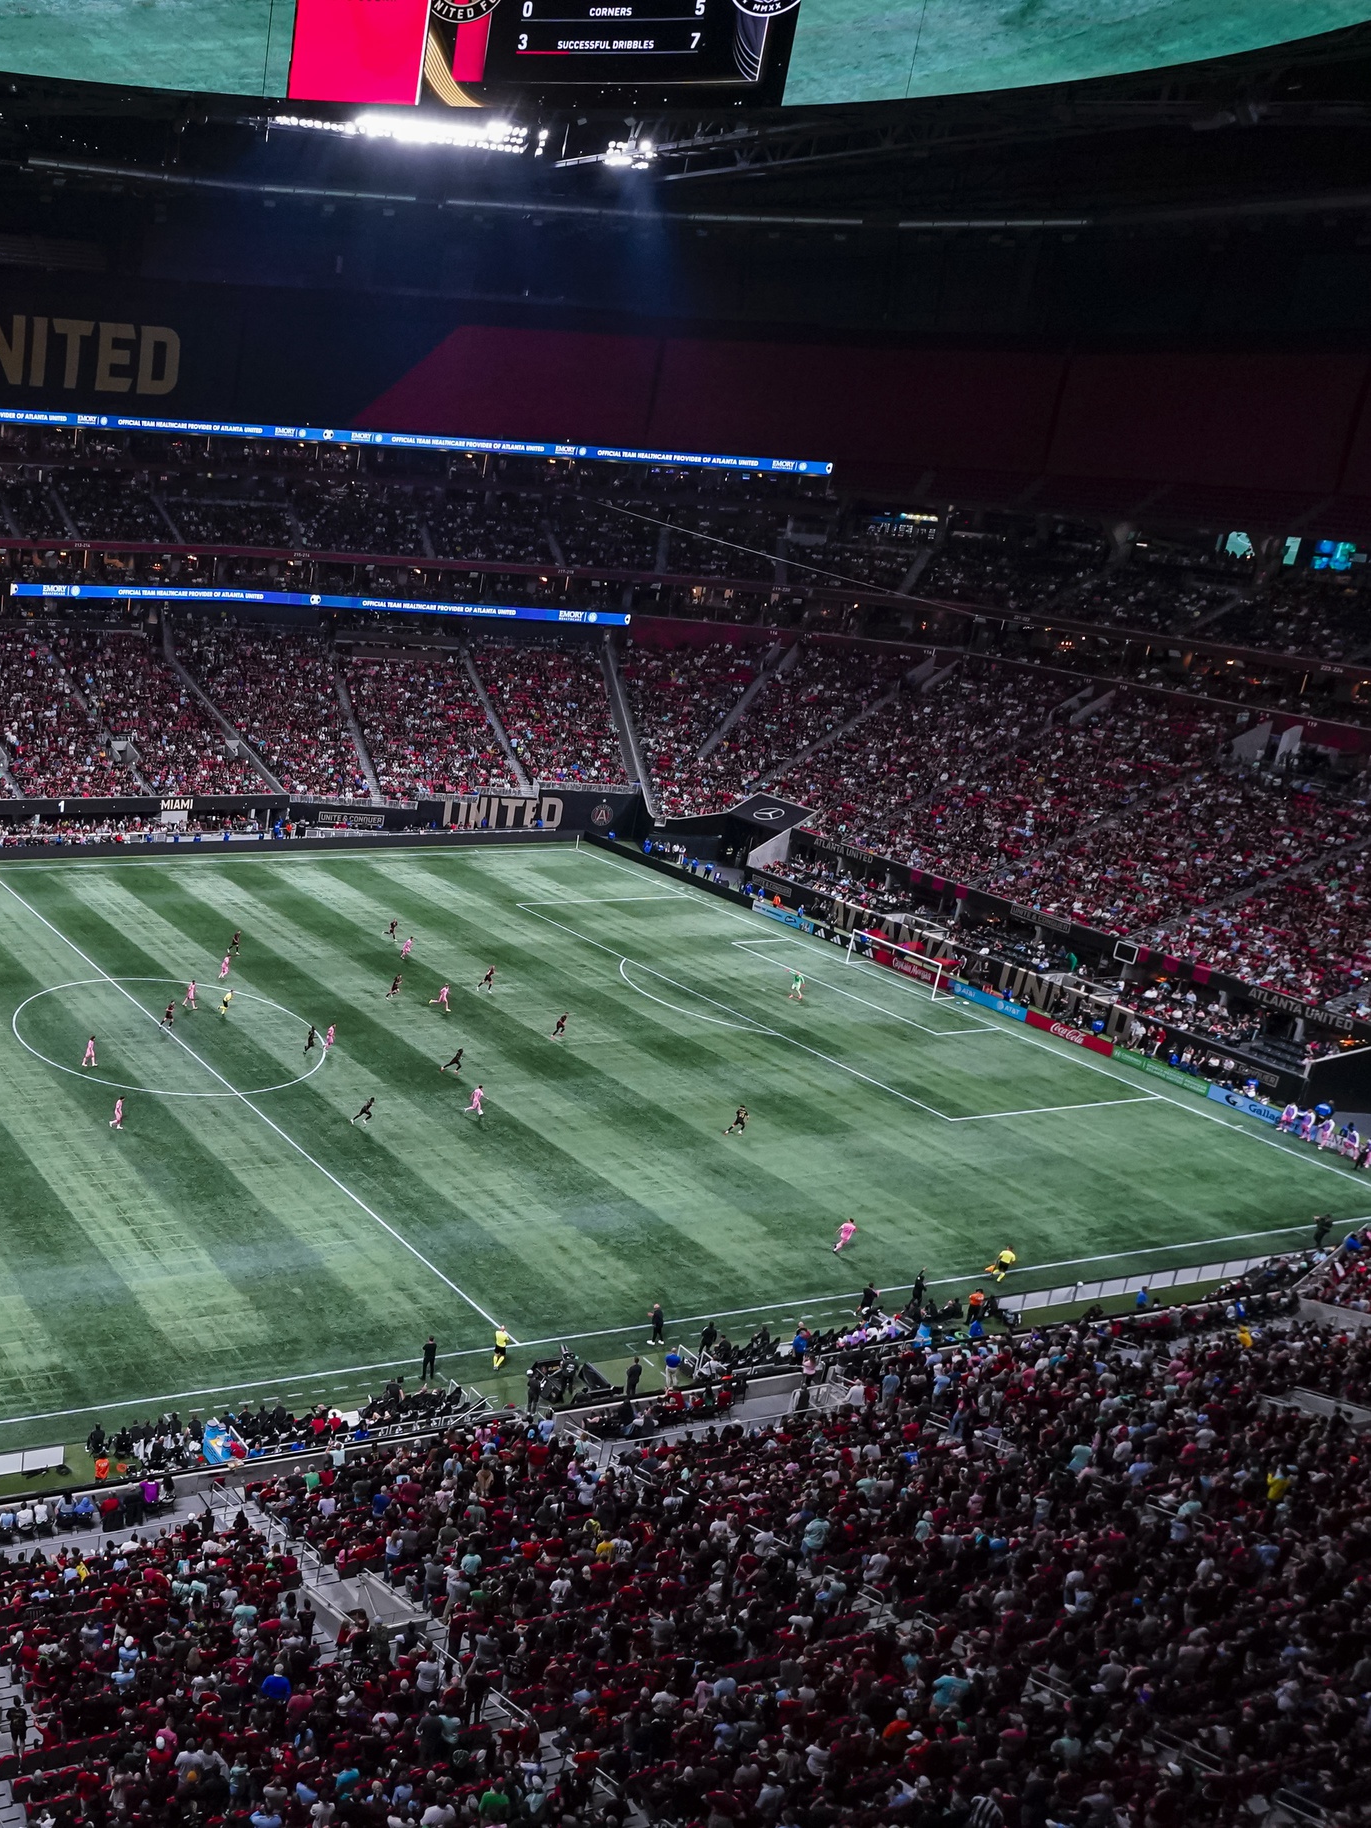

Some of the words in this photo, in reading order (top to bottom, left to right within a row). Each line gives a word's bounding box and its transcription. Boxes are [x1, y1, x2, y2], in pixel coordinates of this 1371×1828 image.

[433, 1, 474, 19] NITED
[523, 1, 533, 17] 0
[589, 7, 632, 17] CORNERS
[695, 0, 705, 15] 5
[753, 3, 781, 12] MMXX
[518, 34, 528, 50] 3
[557, 40, 611, 49] SUCCESSFUL
[612, 40, 654, 49] DRIBBLES
[691, 33, 700, 48] 7
[25, 413, 47, 421] ATLANTA
[555, 445, 575, 453] EMORY
[597, 449, 621, 457] OFFICIAL
[638, 452, 672, 460] HEALTHCARE
[673, 454, 701, 462] PROVIDER
[712, 457, 736, 465] ATLANTA
[738, 459, 758, 467] UNITED
[772, 460, 795, 468] EMORY
[42, 585, 67, 593] EMORY
[363, 600, 385, 608] OFFICIAL
[387, 601, 401, 609] TEAM
[403, 602, 436, 610] HEALTHCARE
[437, 605, 463, 613] PROVIDER
[497, 608, 516, 616] UNITED
[559, 610, 584, 619] EMORY
[58, 801, 65, 813] 1
[161, 799, 193, 810] MIAMI
[442, 797, 563, 829] UNITED
[320, 813, 341, 823] UNITE
[349, 816, 383, 826] CONQUER
[814, 838, 844, 855] ATLANTA
[846, 848, 873, 863] UNITED
[892, 956, 912, 974] Captain
[912, 965, 932, 981] Morgan
[1003, 1004, 1020, 1016] AT&T
[1248, 987, 1302, 1015] ATLANTA
[1305, 1006, 1354, 1031] UNITED
[1050, 1022, 1085, 1045] Coca-Cola
